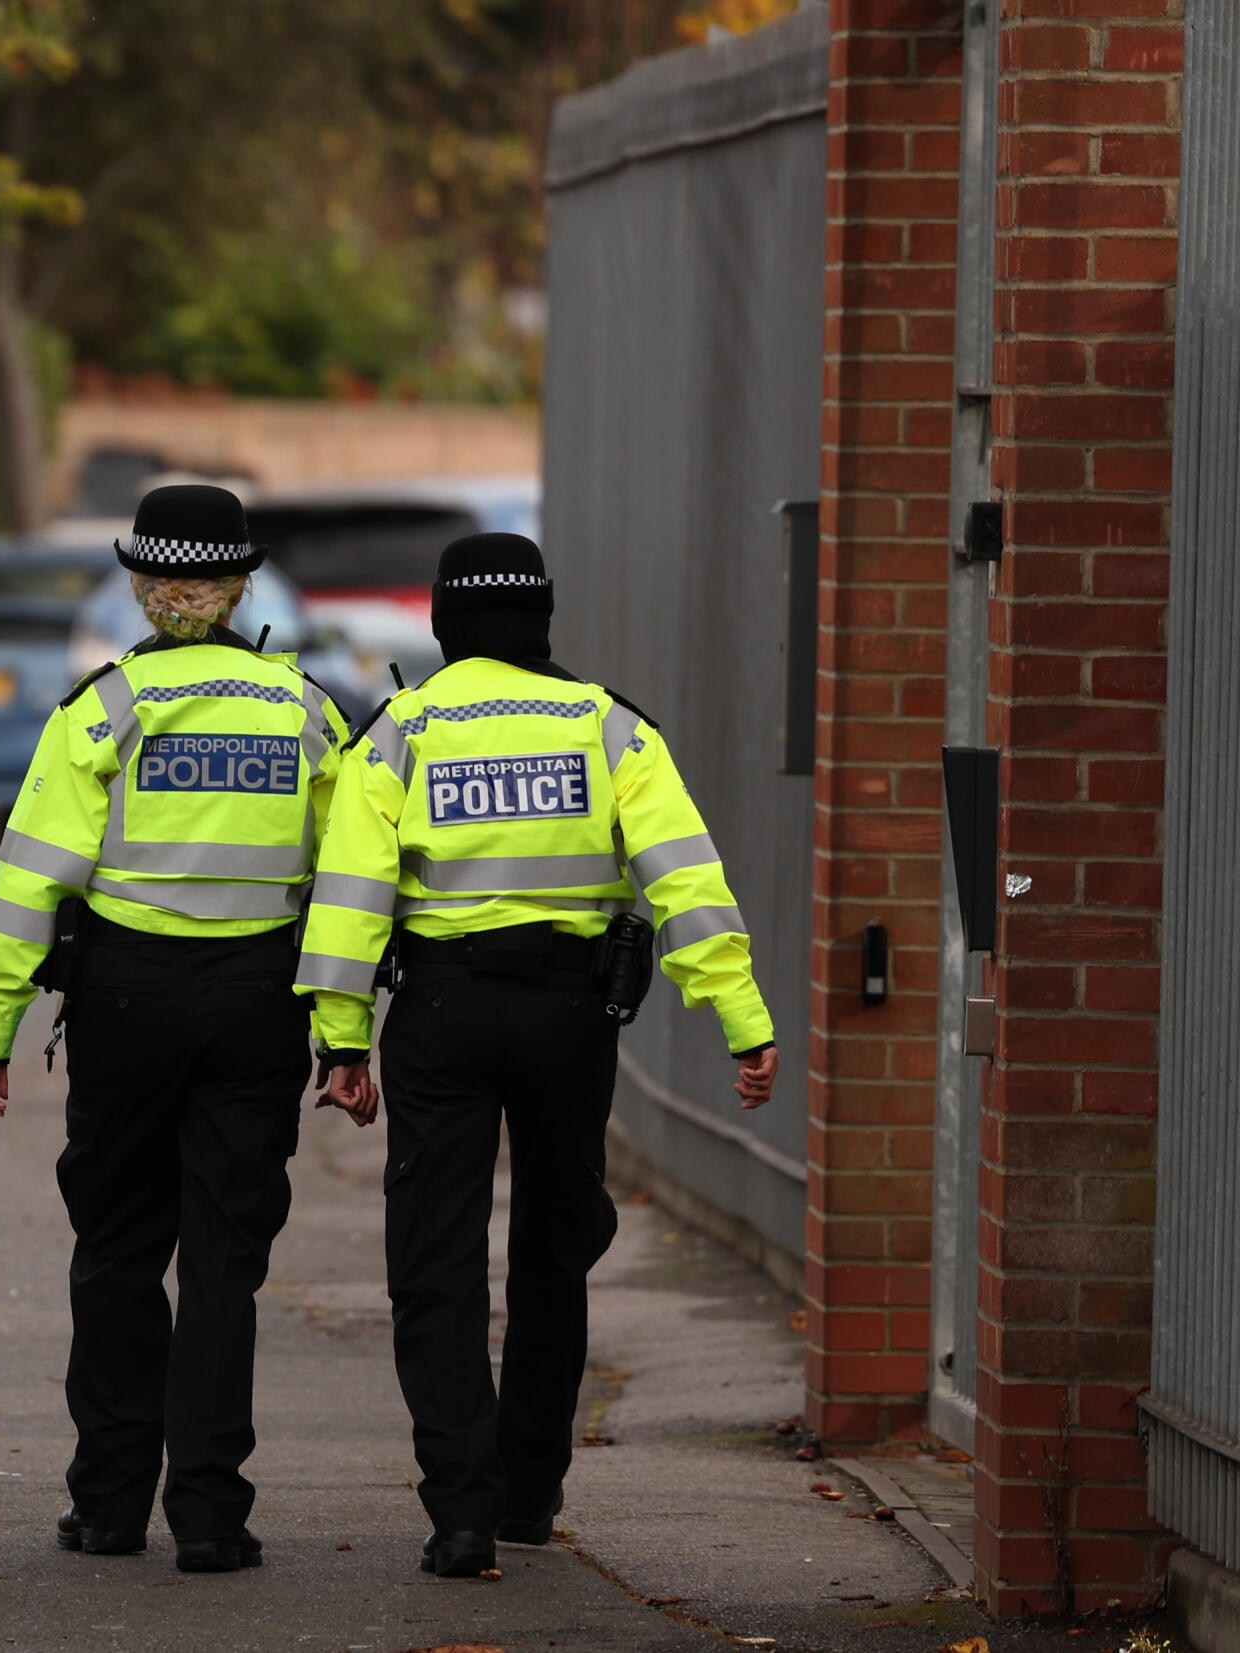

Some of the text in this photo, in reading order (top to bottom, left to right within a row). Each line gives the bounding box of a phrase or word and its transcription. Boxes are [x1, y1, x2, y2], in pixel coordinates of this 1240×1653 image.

[144, 737, 297, 756] METROPOLITAN
[140, 755, 295, 789] POLICE
[432, 758, 581, 779] METROPOLITAN
[433, 774, 584, 819] POLICE
